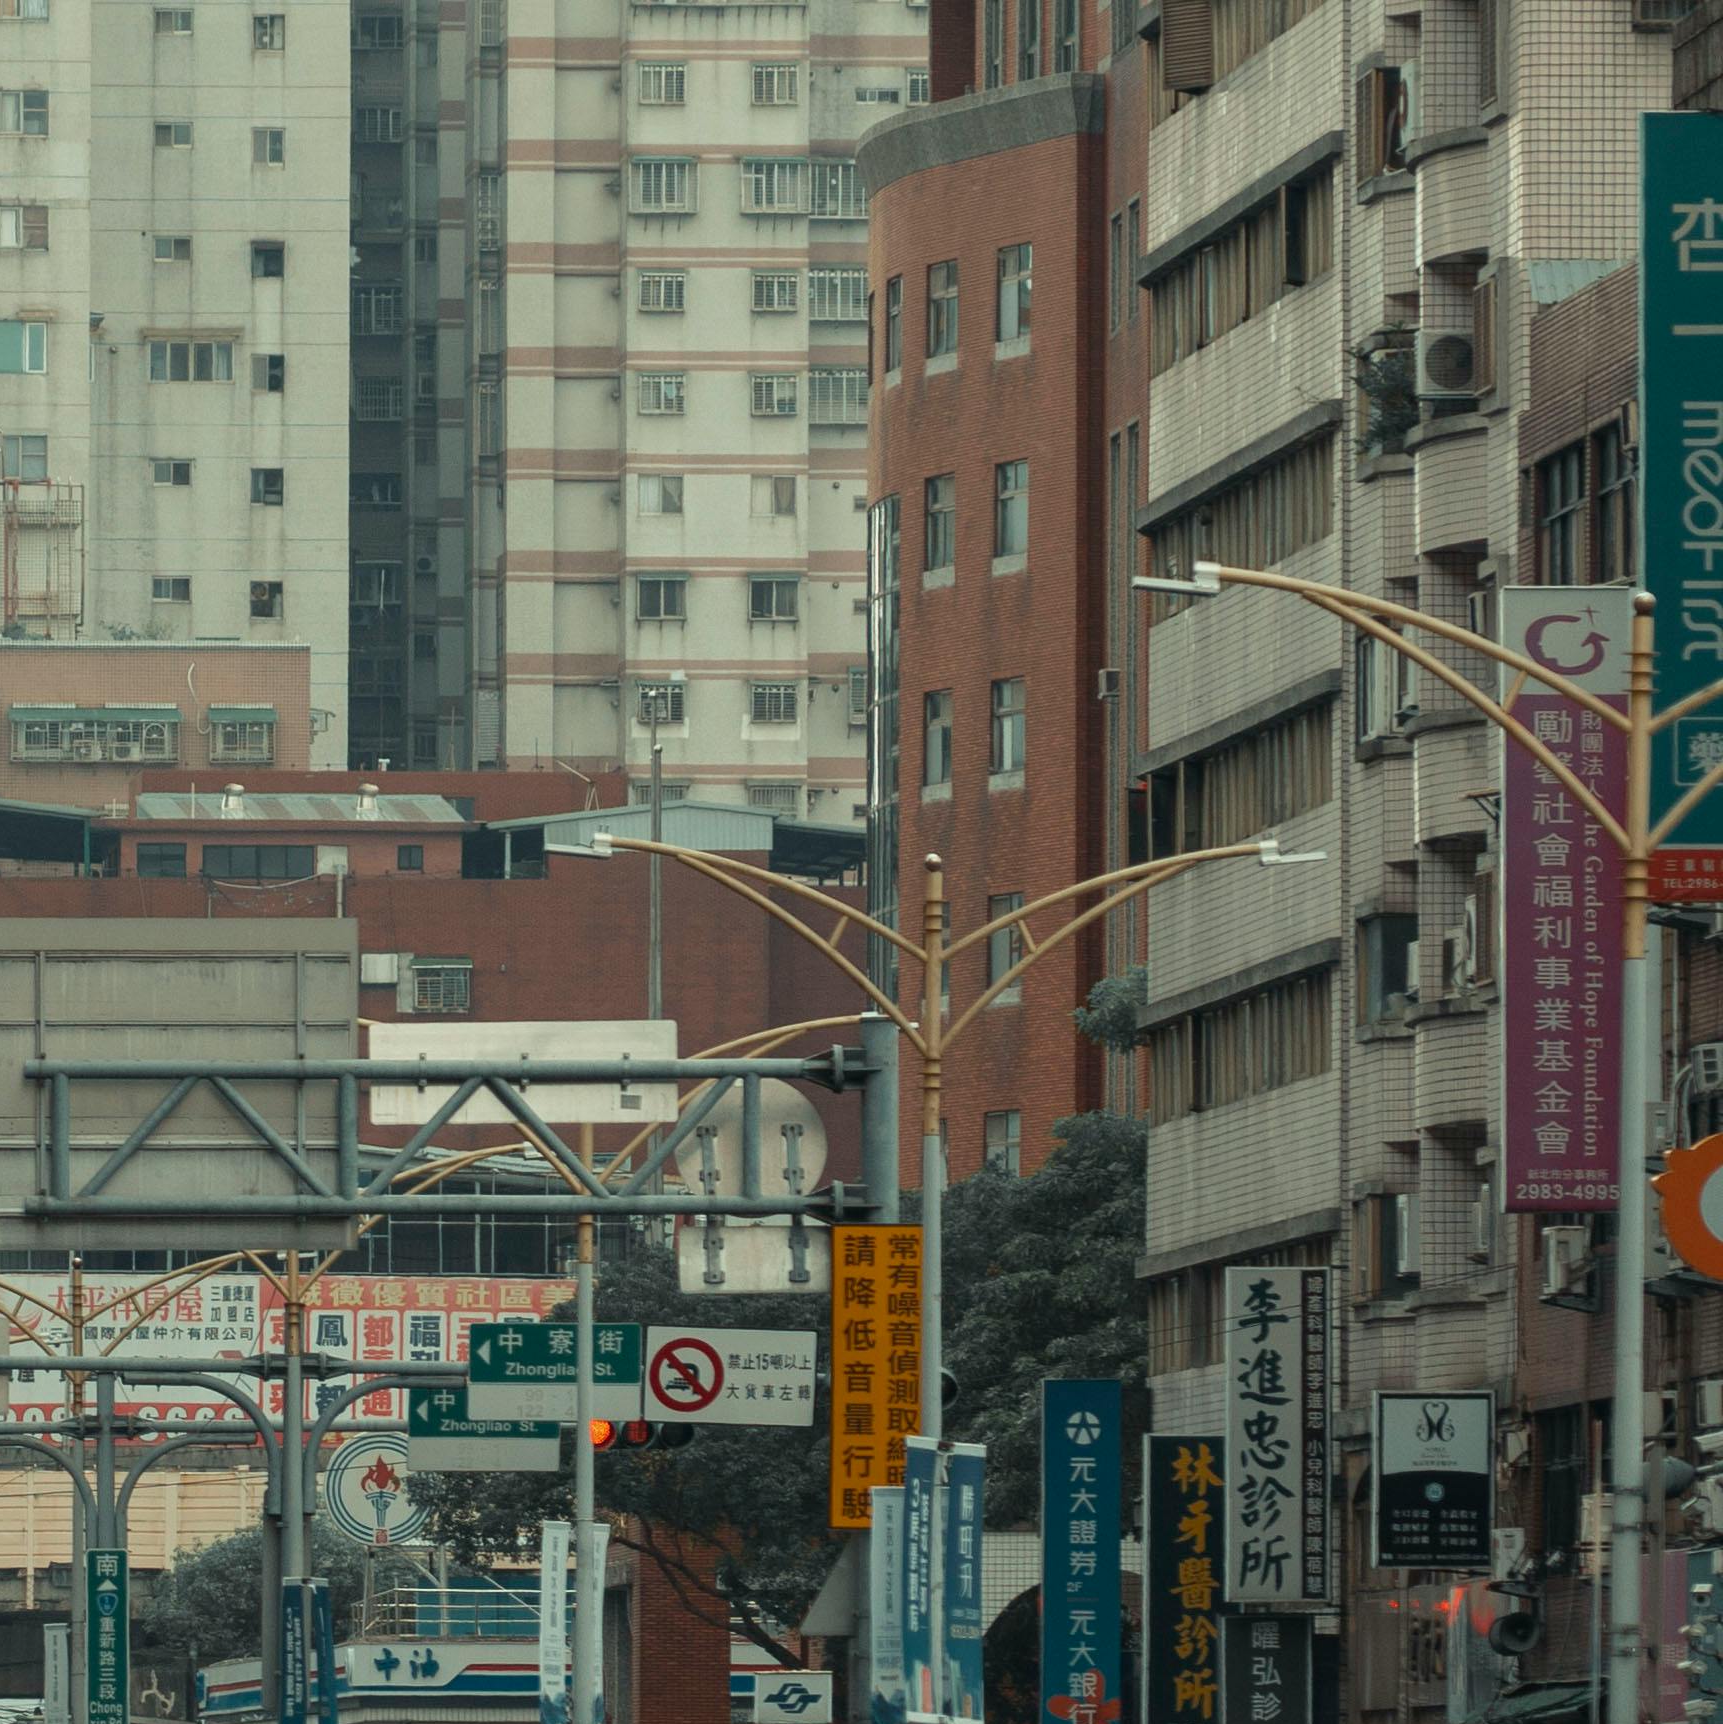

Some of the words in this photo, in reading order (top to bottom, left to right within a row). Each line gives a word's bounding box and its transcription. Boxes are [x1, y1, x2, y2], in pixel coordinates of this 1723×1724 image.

[1579, 972, 1603, 1028] Hope
[1584, 1036, 1603, 1157] Foundation
[210, 1306, 255, 1323] 加盟店
[497, 1329, 624, 1354] 中寮街
[594, 1363, 617, 1377] St.
[440, 1419, 512, 1433] Zhongliao
[518, 1419, 539, 1433] St.
[1237, 1278, 1296, 1594] 李進忠診所
[1069, 1456, 1097, 1577] 元大證券
[96, 1555, 119, 1577] 南
[1170, 1443, 1225, 1719] 林牙醫診所
[373, 1646, 440, 1682] 中油
